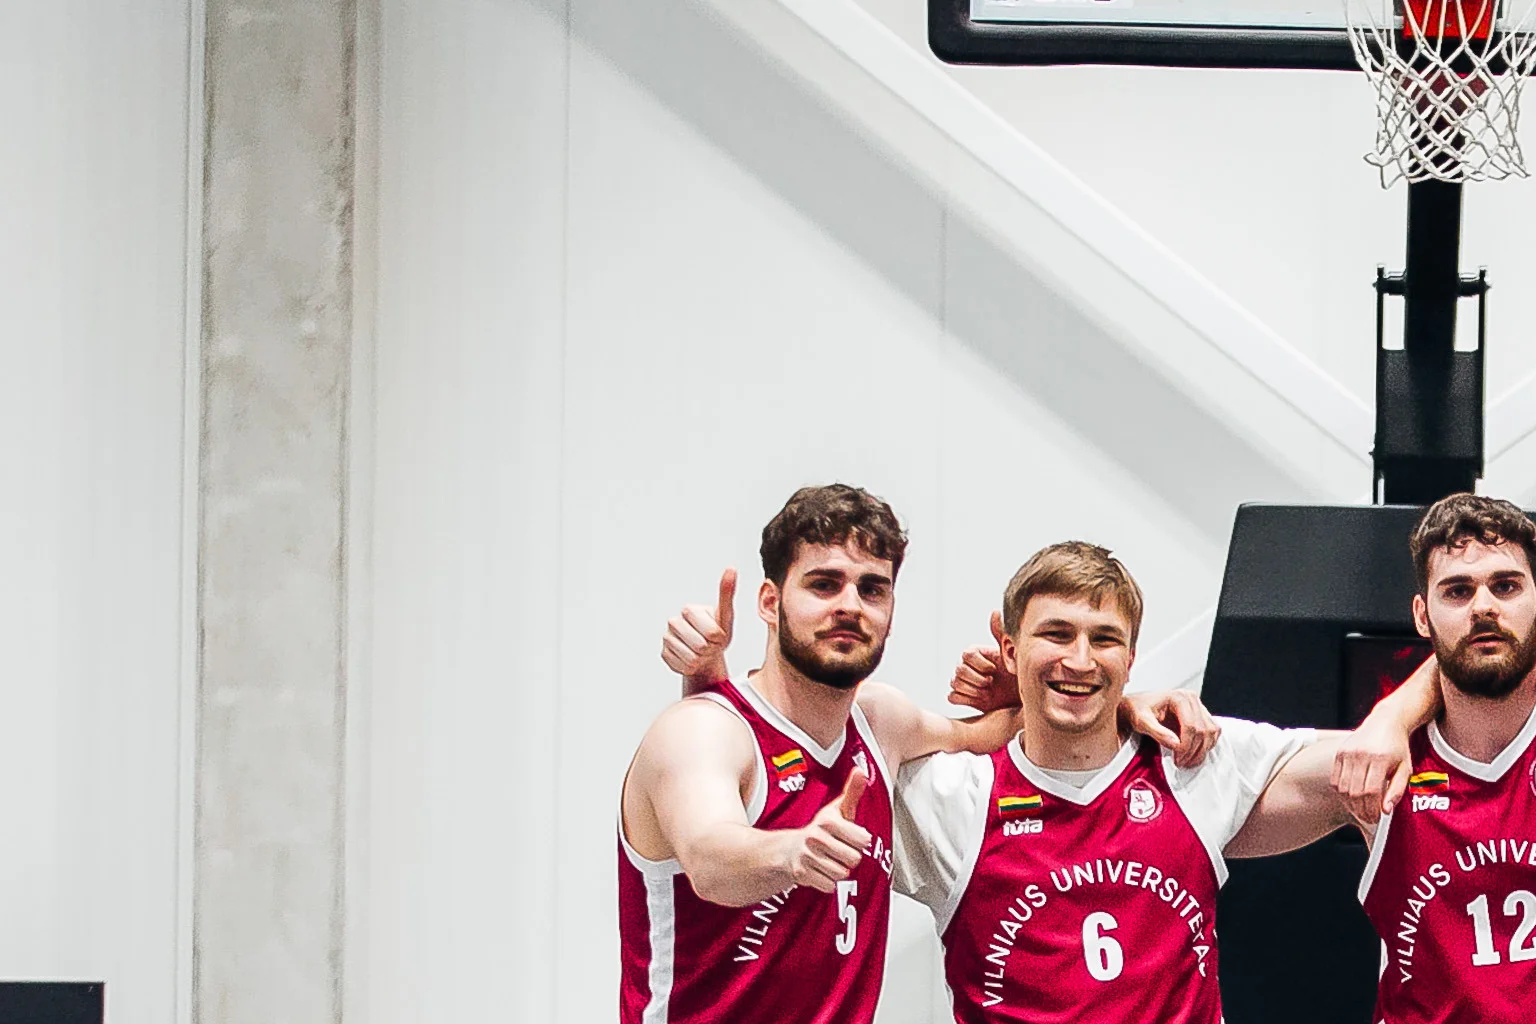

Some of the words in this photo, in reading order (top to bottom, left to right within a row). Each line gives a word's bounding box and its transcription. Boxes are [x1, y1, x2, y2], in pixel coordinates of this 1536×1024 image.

[835, 879, 858, 956] 5
[981, 884, 1048, 1008] VILNIAUS
[1081, 910, 1125, 982] 6
[1397, 862, 1451, 984] VILNIAUS
